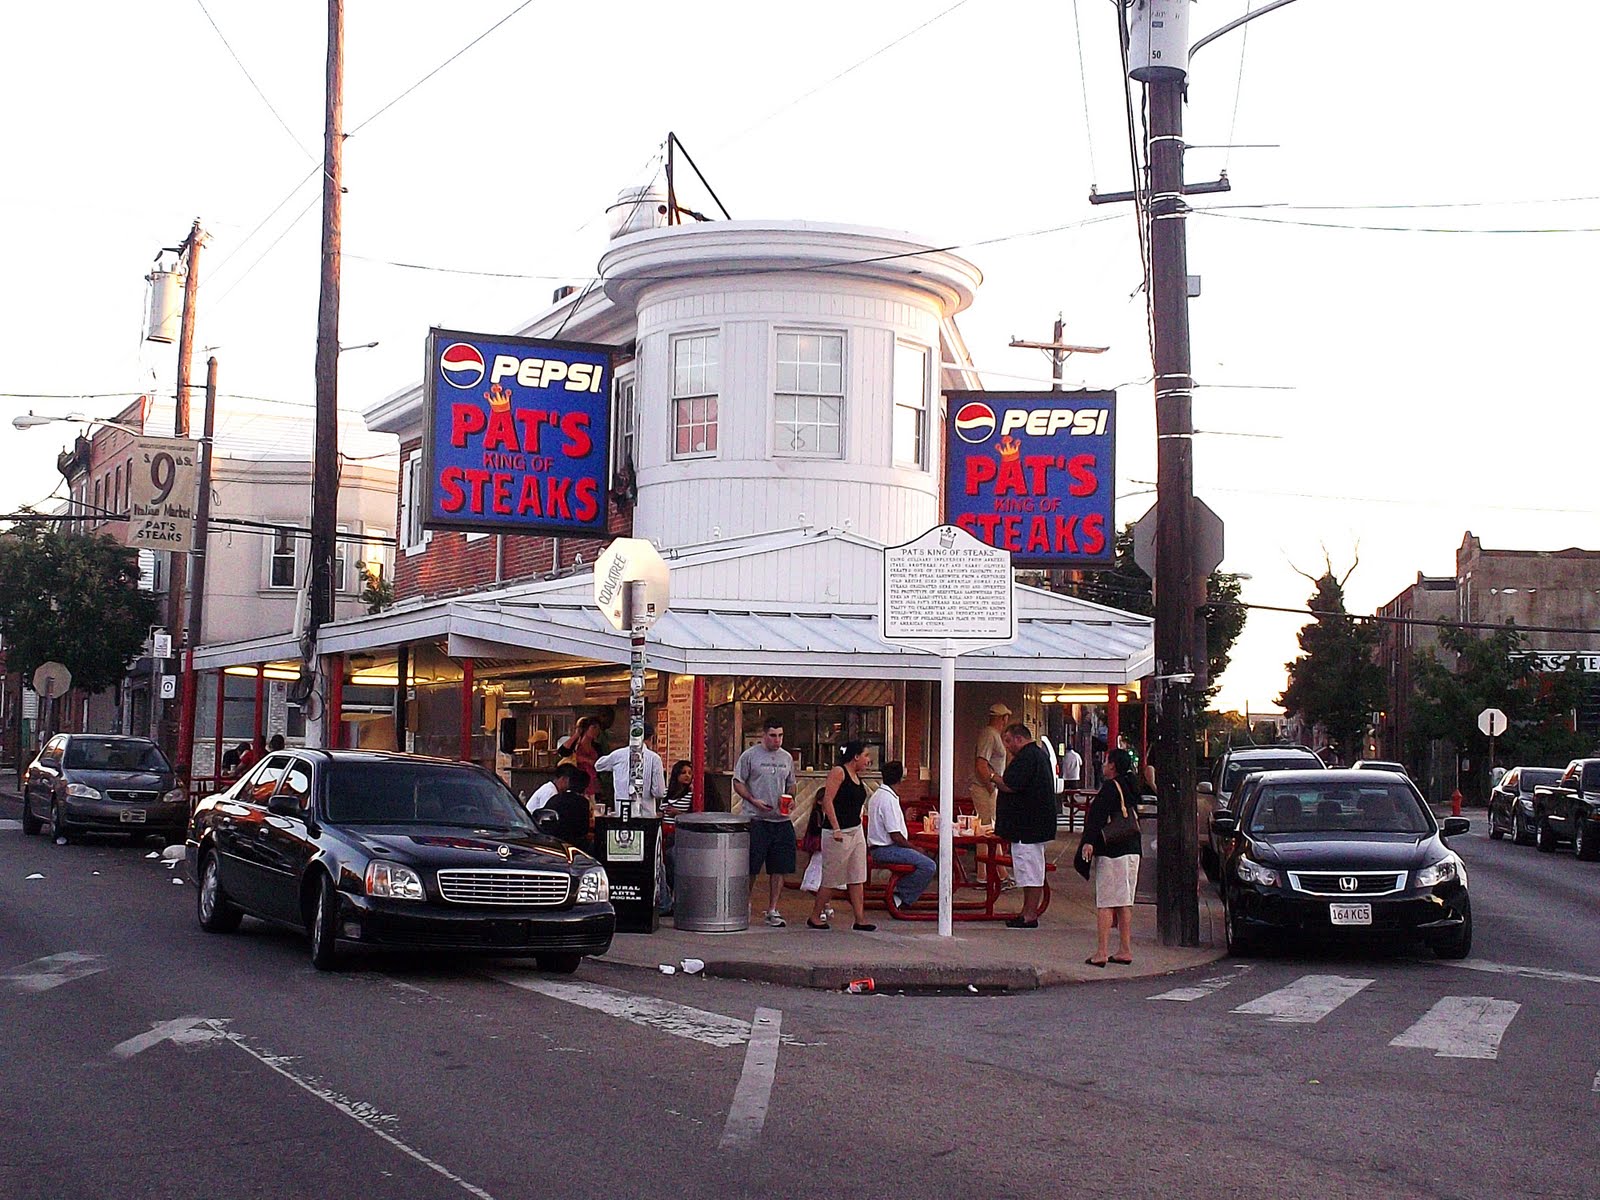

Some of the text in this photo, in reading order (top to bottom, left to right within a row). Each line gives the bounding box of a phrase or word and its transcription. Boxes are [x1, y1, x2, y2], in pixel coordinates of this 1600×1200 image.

[1152, 50, 1161, 59] 50
[491, 355, 603, 393] PEPSI
[450, 402, 594, 460] PAT'S
[1000, 409, 1109, 436] PEPSI
[483, 451, 554, 472] KING OF
[965, 453, 1099, 497] PAT'S
[440, 466, 599, 522] STEAKS
[164, 503, 191, 519] Market
[994, 498, 1062, 513] KING OF
[137, 530, 182, 542] STEAKS
[145, 520, 176, 532] PAT'S
[956, 512, 1107, 555] STEAKS
[1333, 909, 1349, 920] 164
